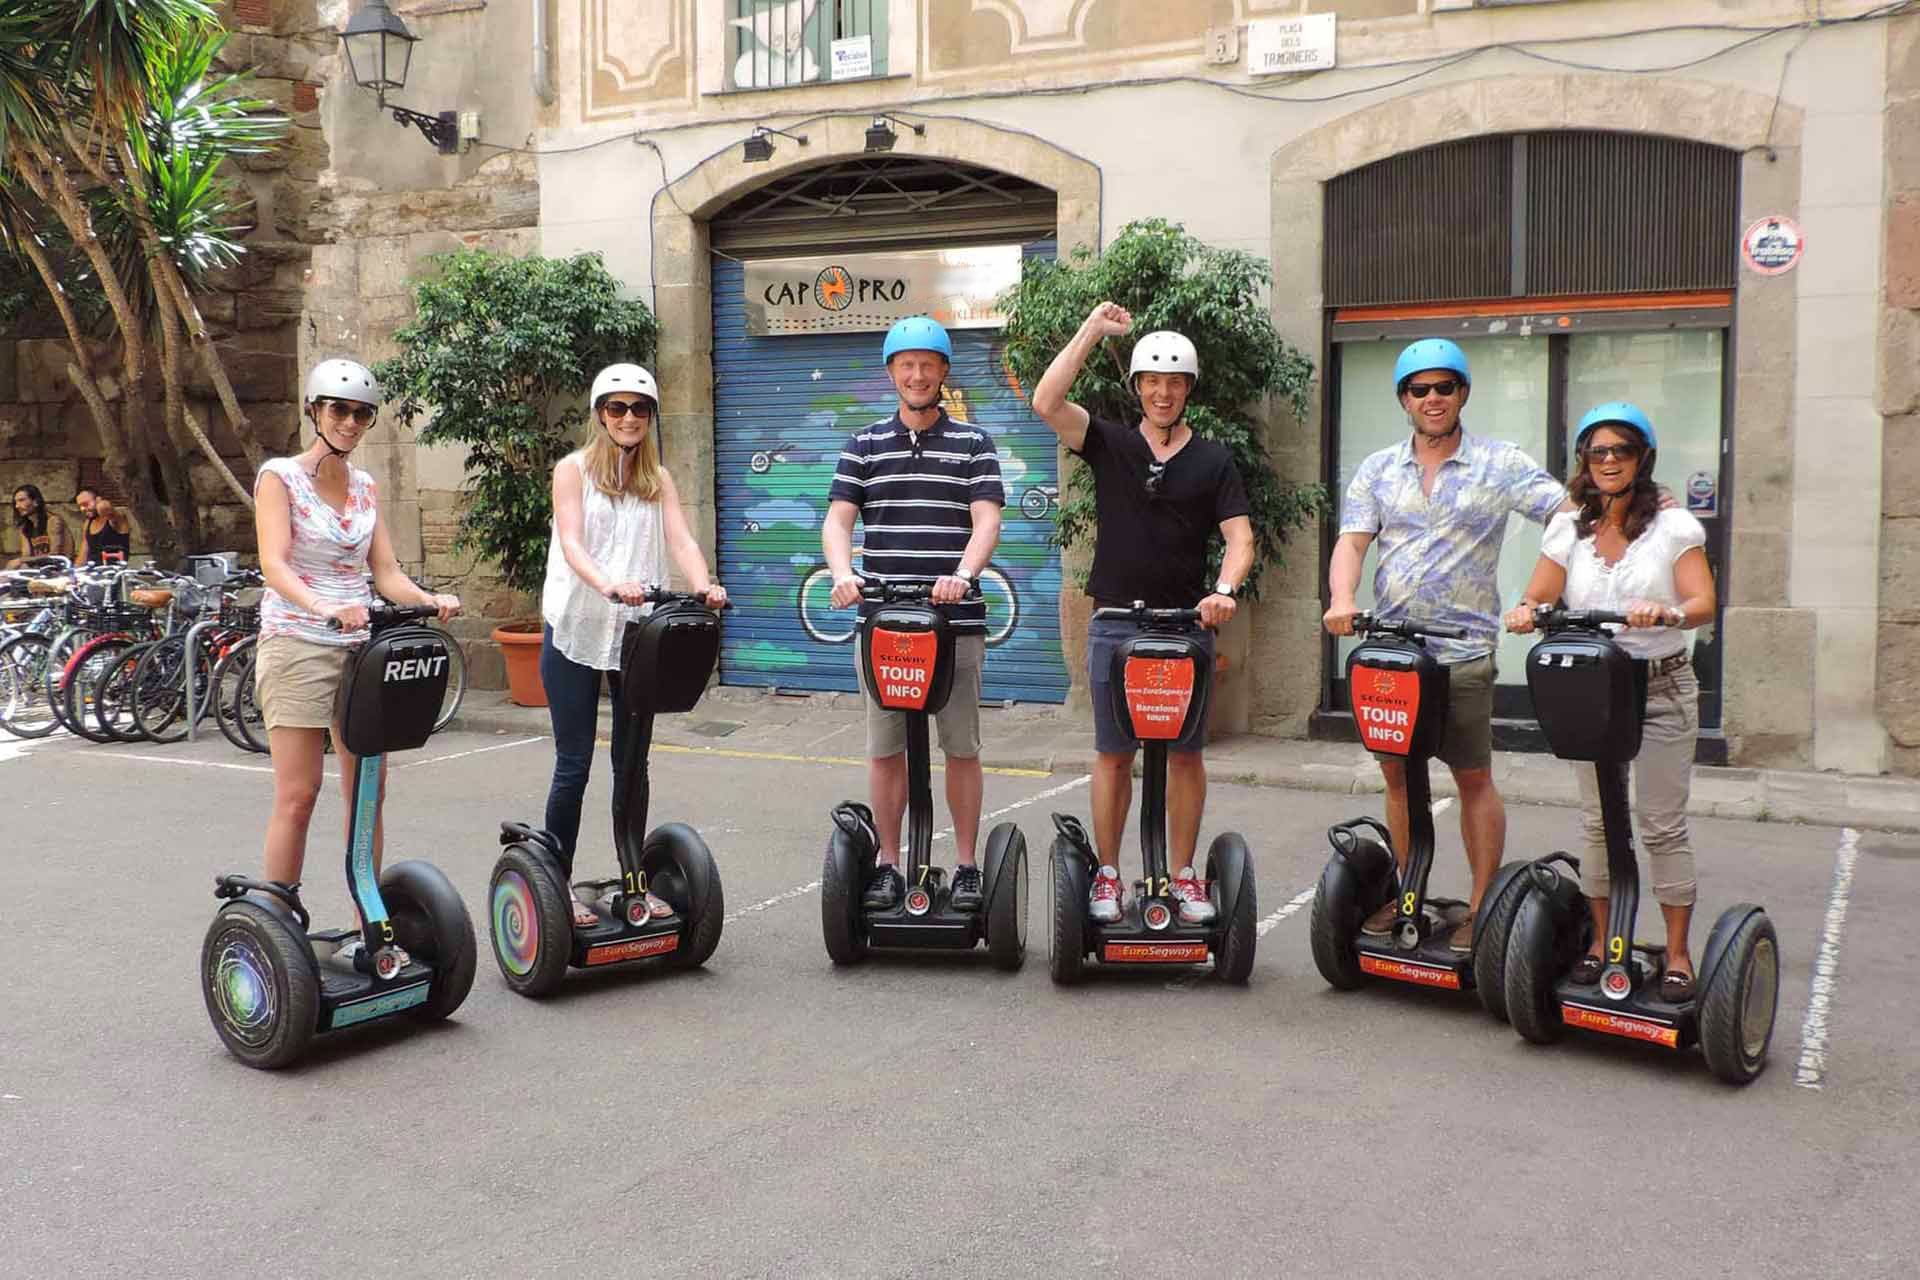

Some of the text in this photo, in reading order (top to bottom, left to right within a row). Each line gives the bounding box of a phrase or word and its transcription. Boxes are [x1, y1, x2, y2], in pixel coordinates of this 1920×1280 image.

[1263, 48, 1321, 68] TRAGINERS
[764, 278, 906, 306] CAP PRO
[384, 655, 447, 682] RENT
[880, 665, 926, 683] TOUR
[886, 684, 922, 699] INFO
[1136, 703, 1179, 713] Barcelona
[1147, 713, 1170, 721] tours
[1360, 706, 1408, 727] TOUR
[1368, 726, 1405, 743] INFO
[626, 870, 648, 894] 10
[918, 864, 929, 886] 7
[1145, 877, 1169, 897] 12
[1402, 892, 1416, 916] 8
[381, 919, 394, 943] 5
[1122, 945, 1206, 958] EuroSegway.es
[1609, 936, 1624, 963] 9
[1375, 959, 1457, 983] EuroSegway.es
[1580, 1010, 1678, 1042] EuroSegway.es
